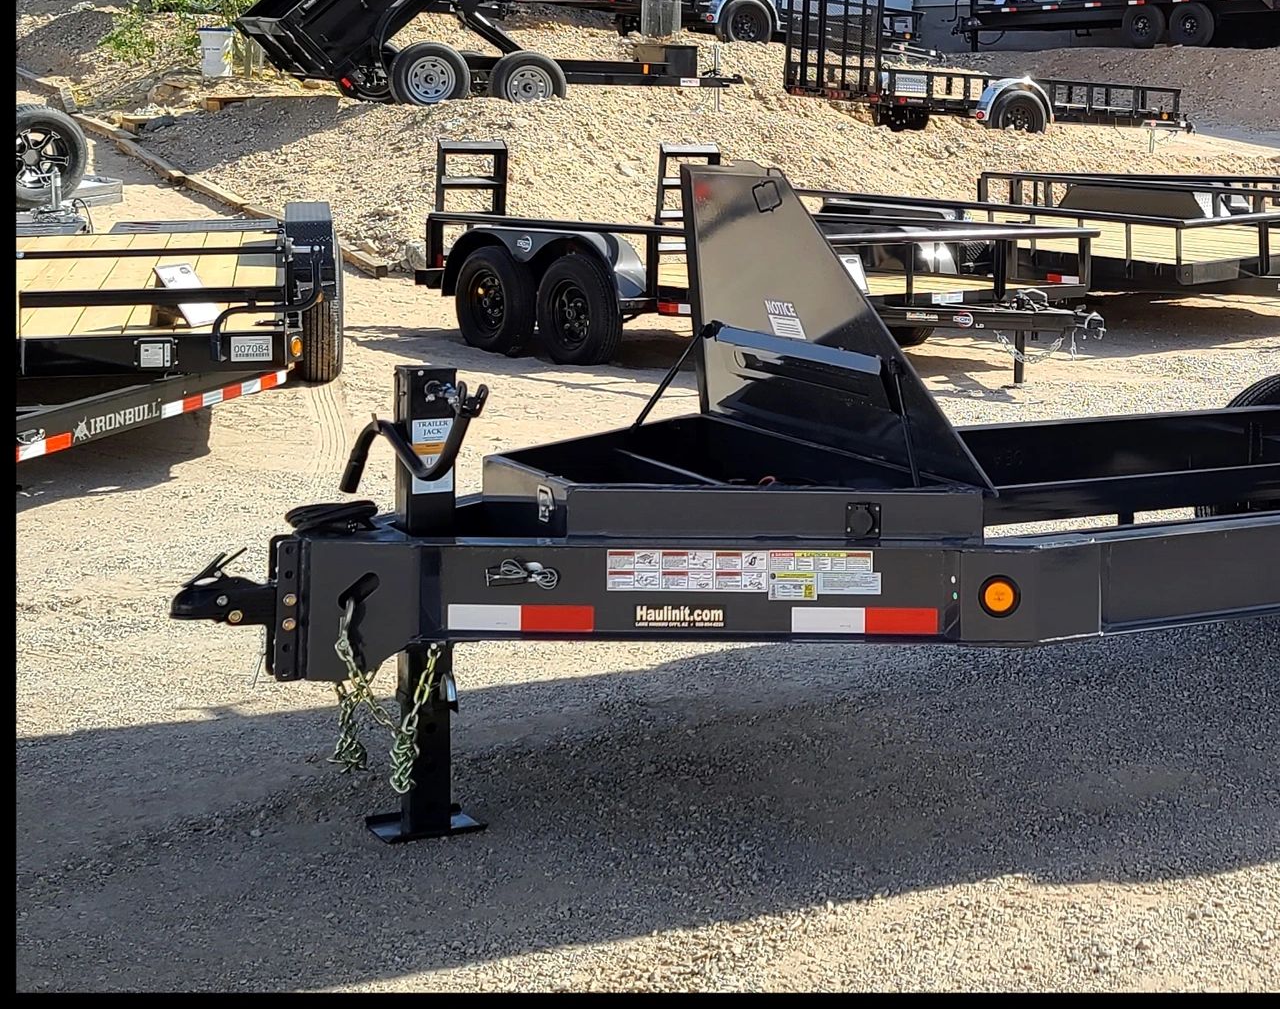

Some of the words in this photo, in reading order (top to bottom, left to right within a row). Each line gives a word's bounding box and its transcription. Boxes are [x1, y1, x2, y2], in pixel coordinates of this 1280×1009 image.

[764, 300, 797, 317] NOTICE
[233, 344, 269, 353] 007084
[89, 401, 160, 435] IRONBULL
[418, 420, 448, 428] TRAILER
[423, 428, 442, 436] JACK
[635, 605, 724, 622] Haulinit.com
